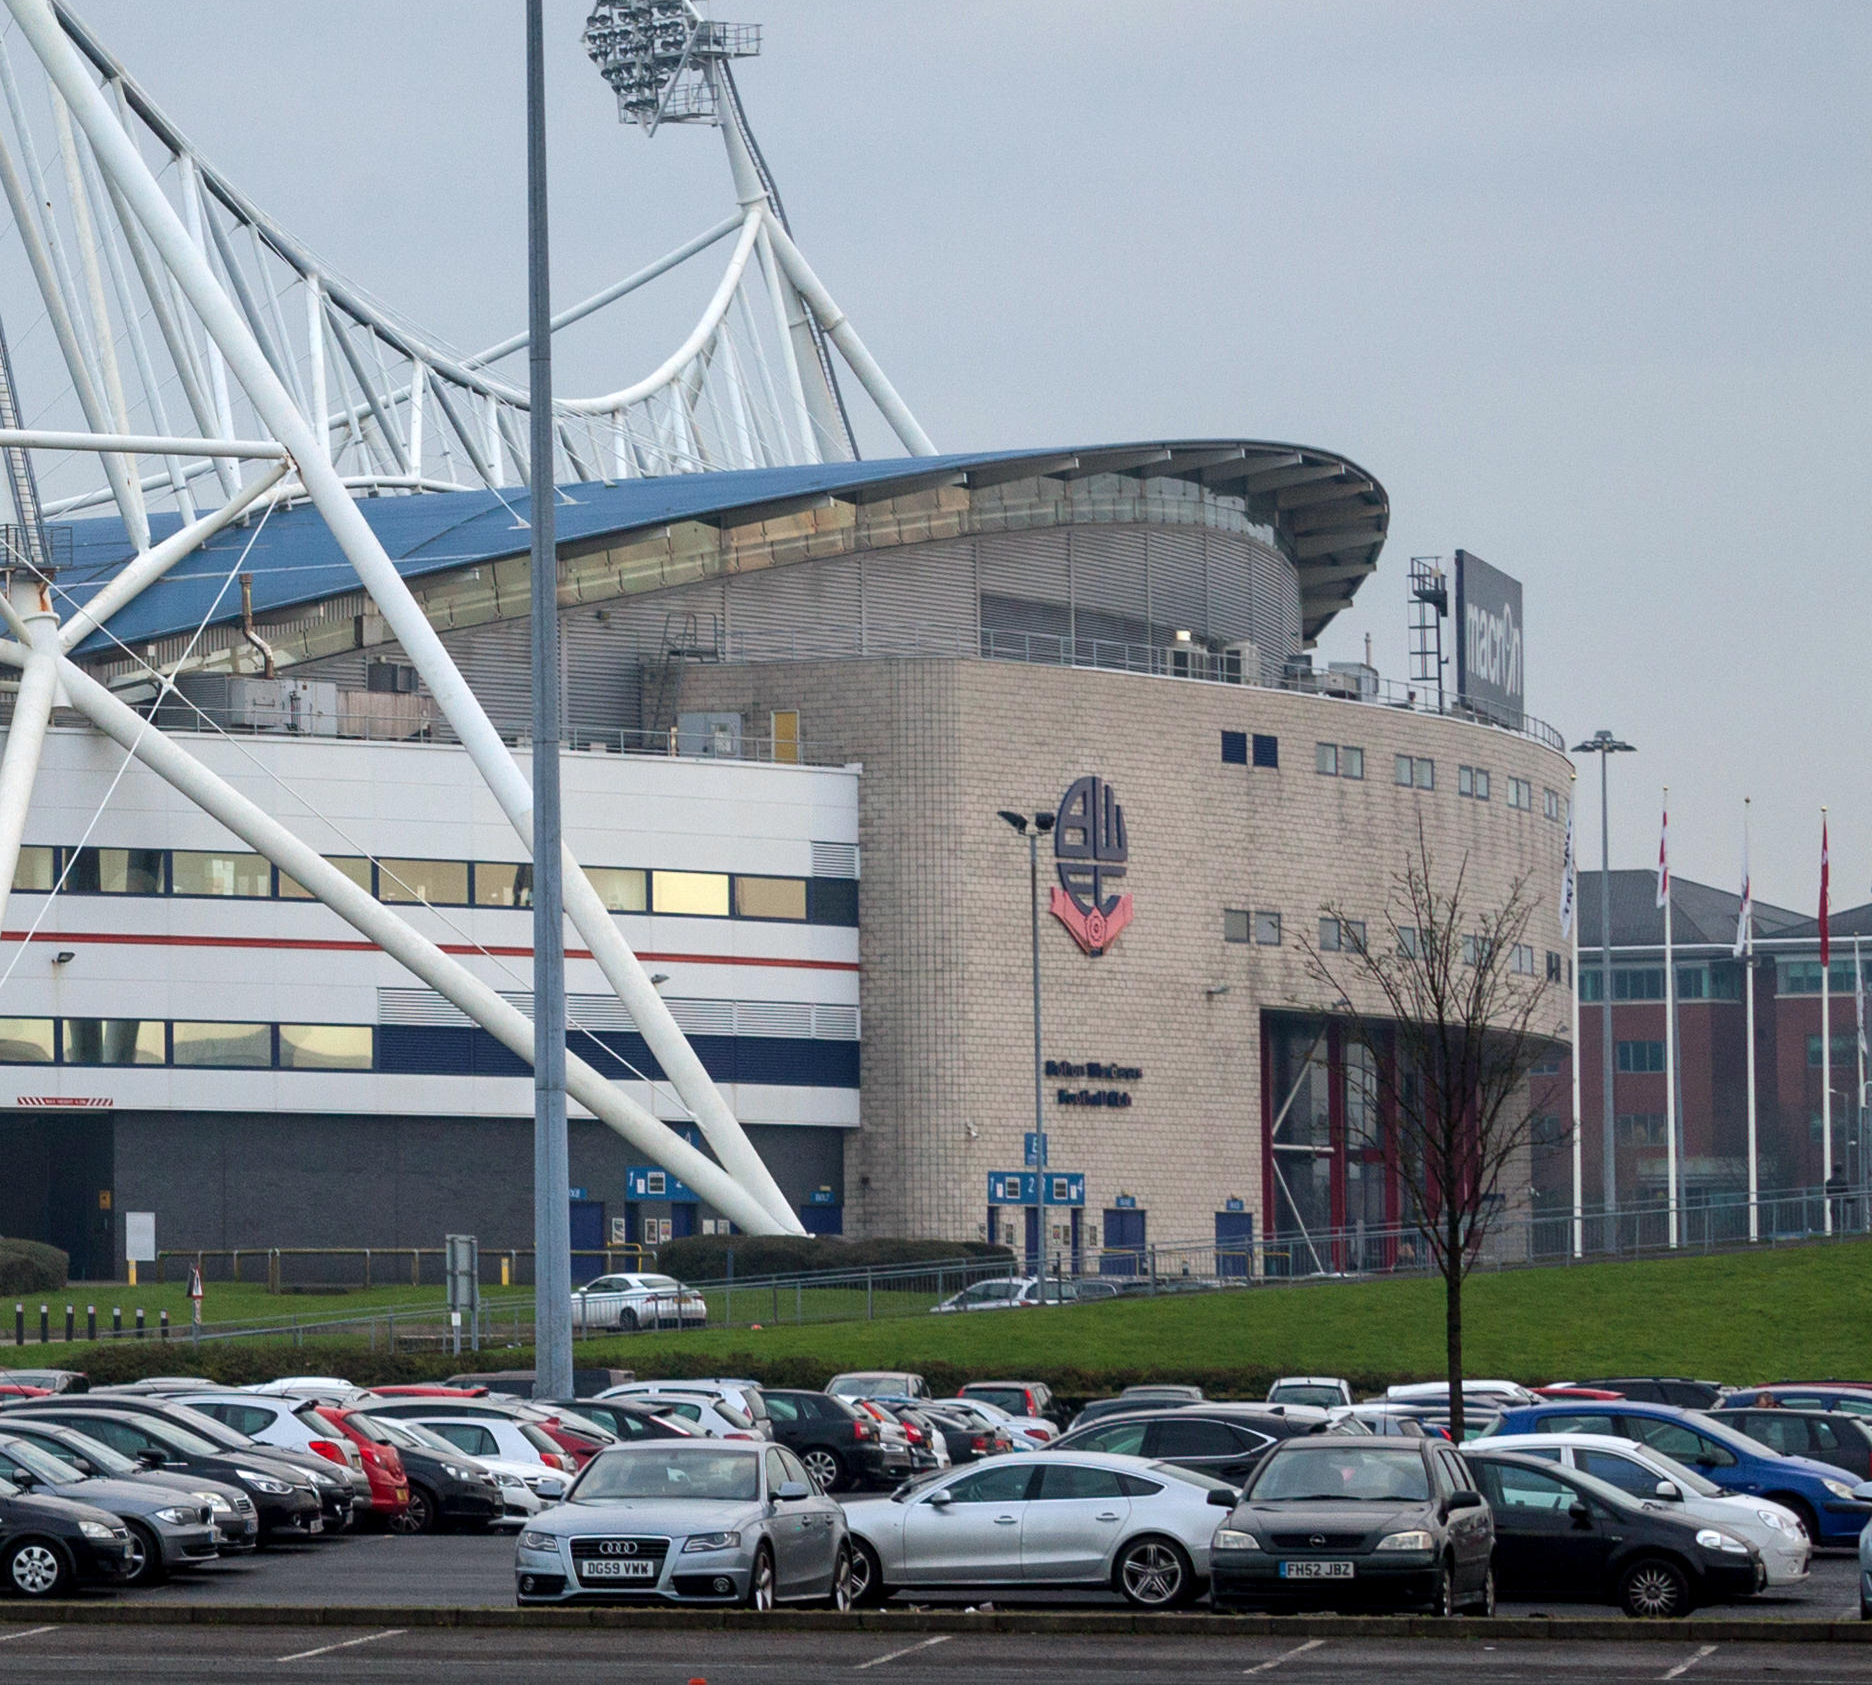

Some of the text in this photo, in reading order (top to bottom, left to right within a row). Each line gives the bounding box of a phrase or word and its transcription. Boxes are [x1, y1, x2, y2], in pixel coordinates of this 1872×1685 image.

[1467, 602, 1521, 697] macron
[587, 1562, 620, 1575] DG59
[1287, 1563, 1350, 1576] FH52 JBZ
